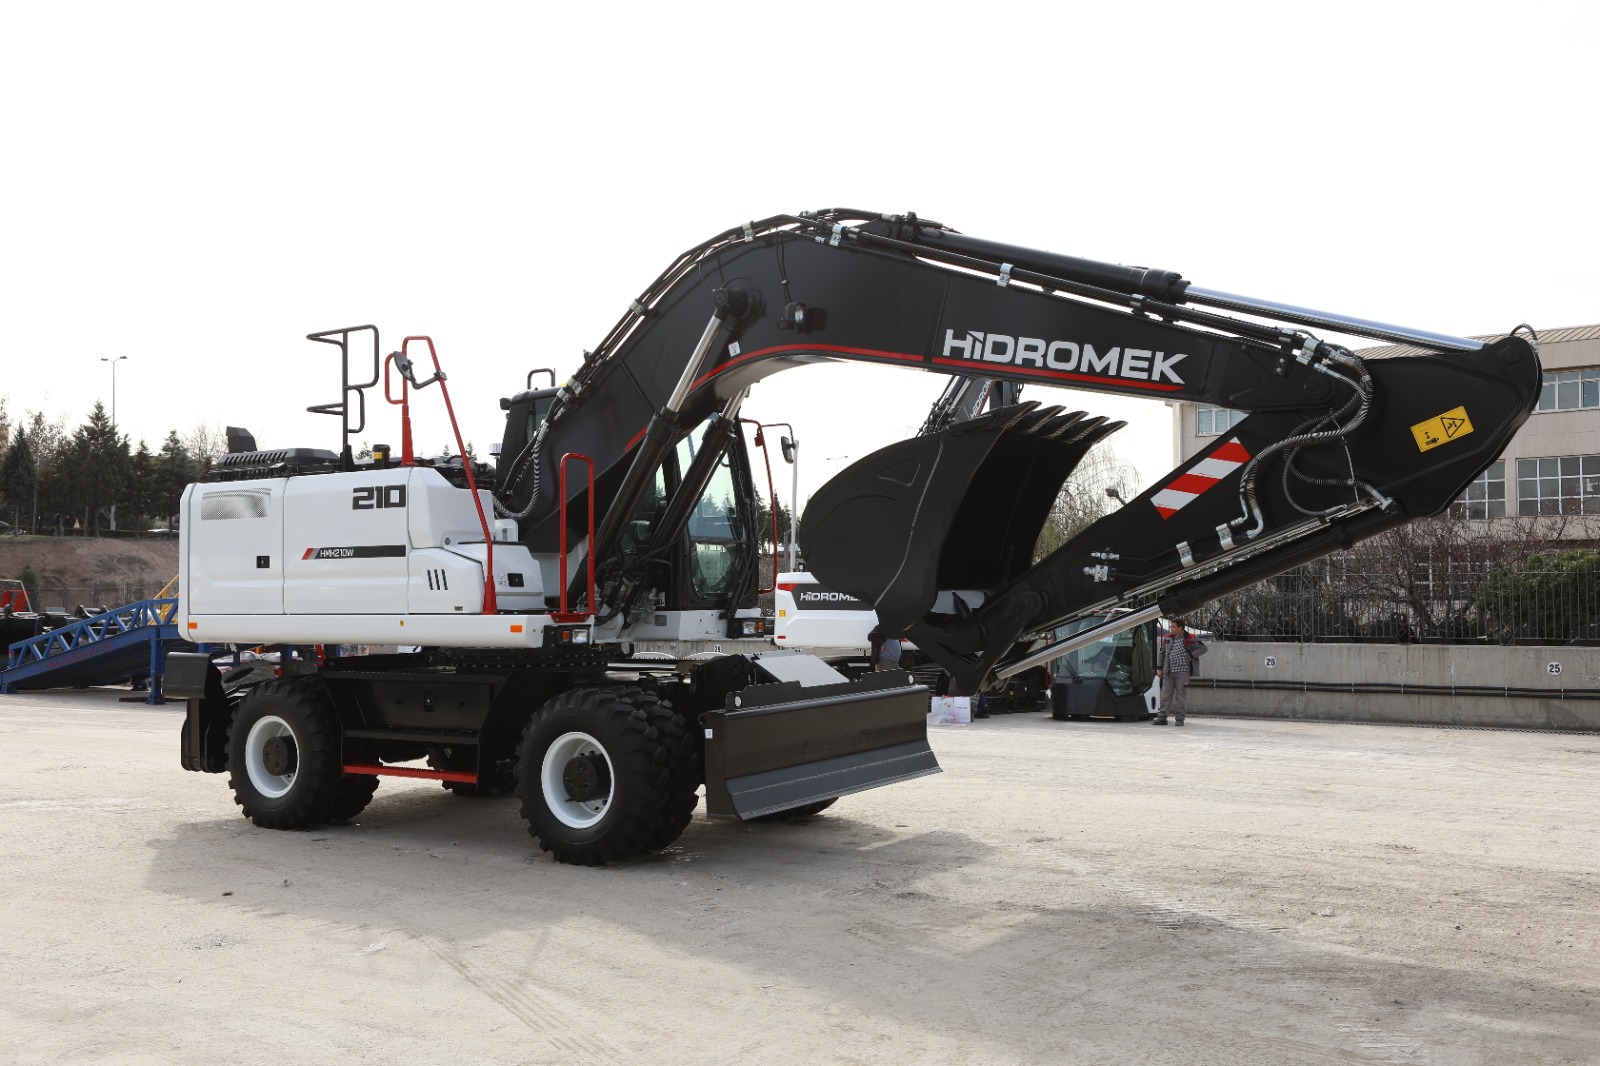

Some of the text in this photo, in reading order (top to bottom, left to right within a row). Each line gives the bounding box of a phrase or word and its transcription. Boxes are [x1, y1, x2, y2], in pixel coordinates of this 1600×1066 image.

[352, 484, 407, 510] 210
[320, 548, 354, 558] HMK210W
[1549, 664, 1561, 673] 25
